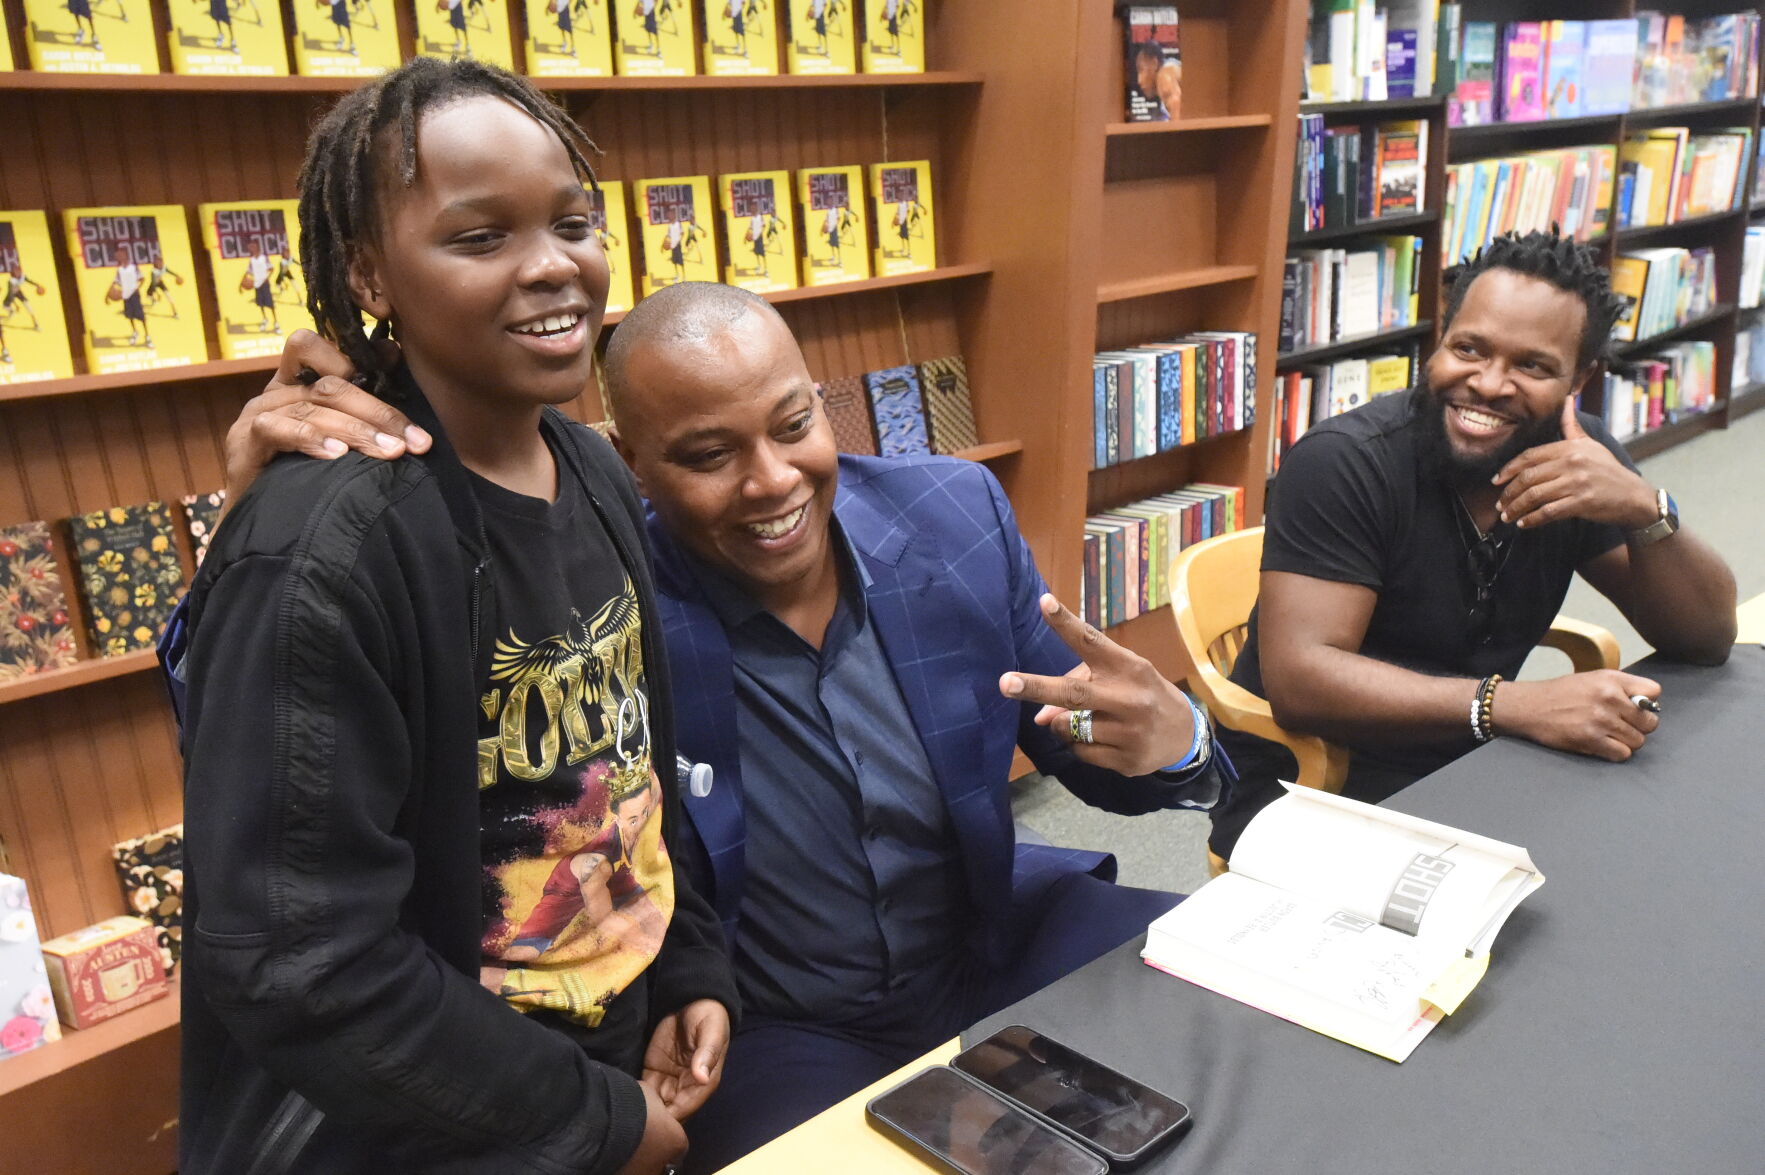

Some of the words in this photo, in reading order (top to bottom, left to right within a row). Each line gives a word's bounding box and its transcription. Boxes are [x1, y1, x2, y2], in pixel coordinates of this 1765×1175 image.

[649, 185, 686, 204] SHOT
[734, 180, 766, 197] SHOT
[80, 215, 141, 241] SHOT
[216, 210, 272, 233] SHOT
[1388, 853, 1454, 923] SHOT
